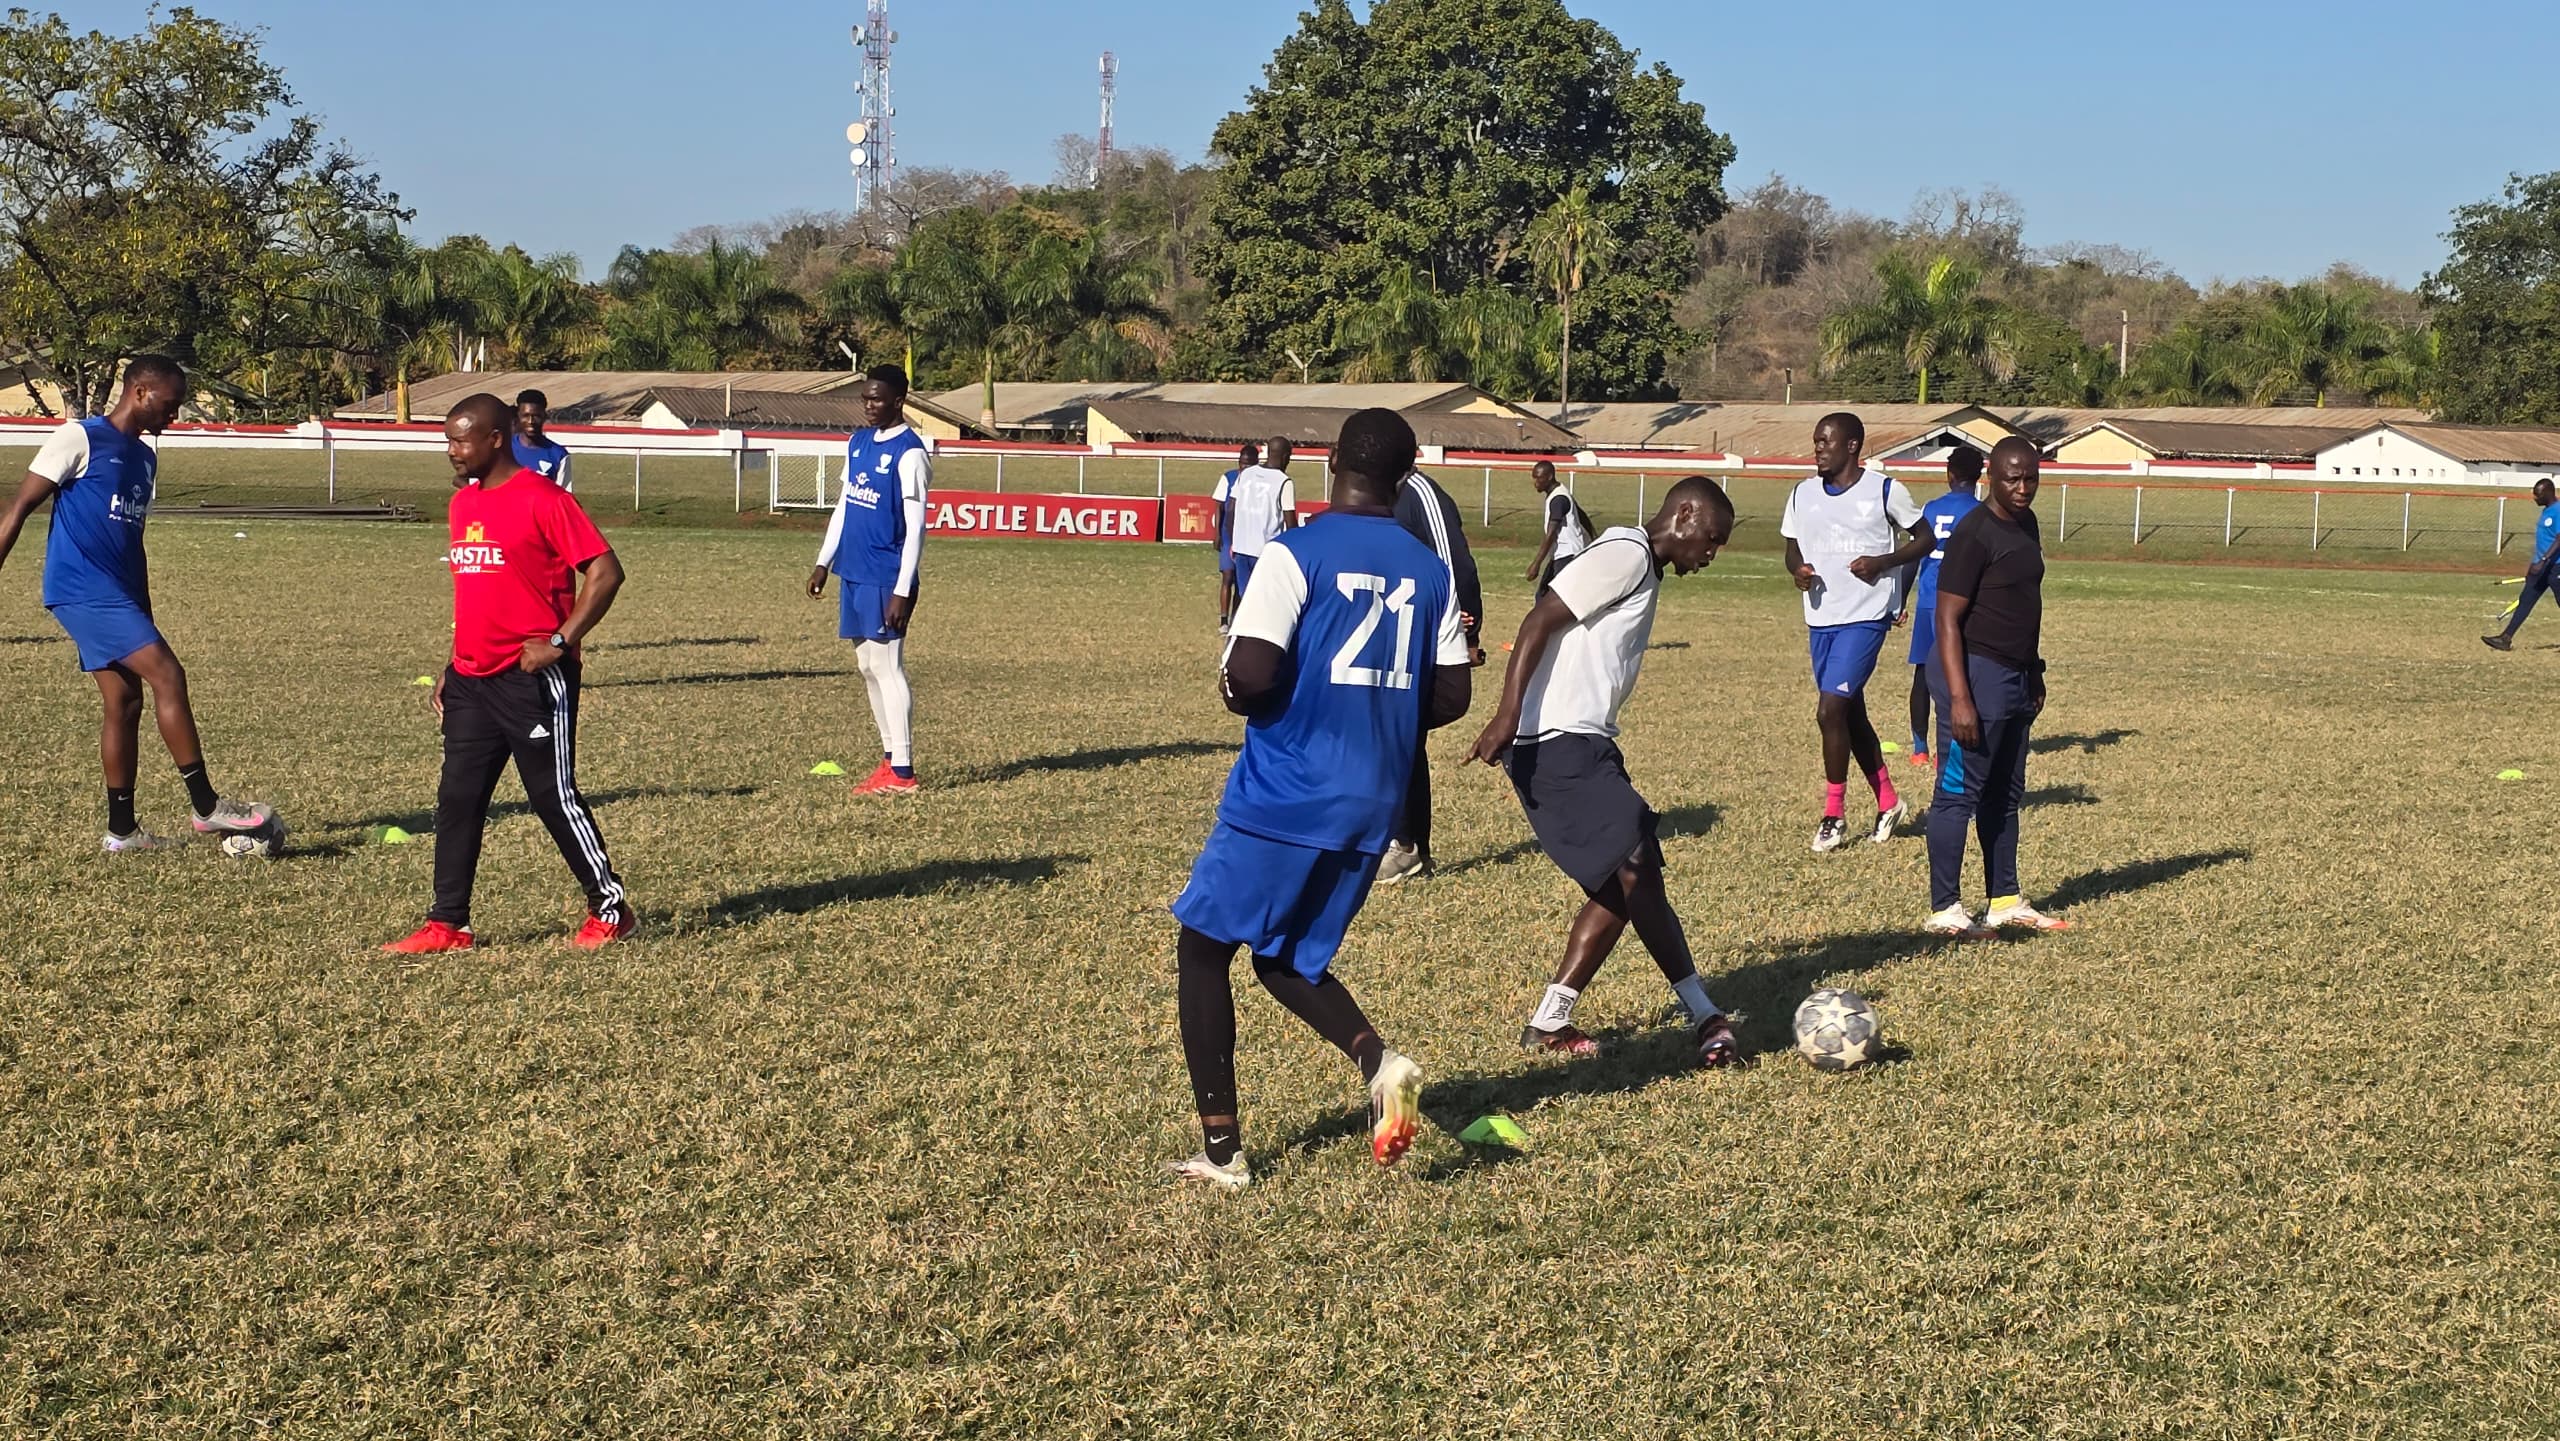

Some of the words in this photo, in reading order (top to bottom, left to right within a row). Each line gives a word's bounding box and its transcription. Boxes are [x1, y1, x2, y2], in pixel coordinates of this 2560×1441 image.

[110, 493, 146, 518] Hule
[1036, 506, 1139, 535] LAGER
[451, 547, 505, 565] CASTLE
[1330, 572, 1415, 689] 21
